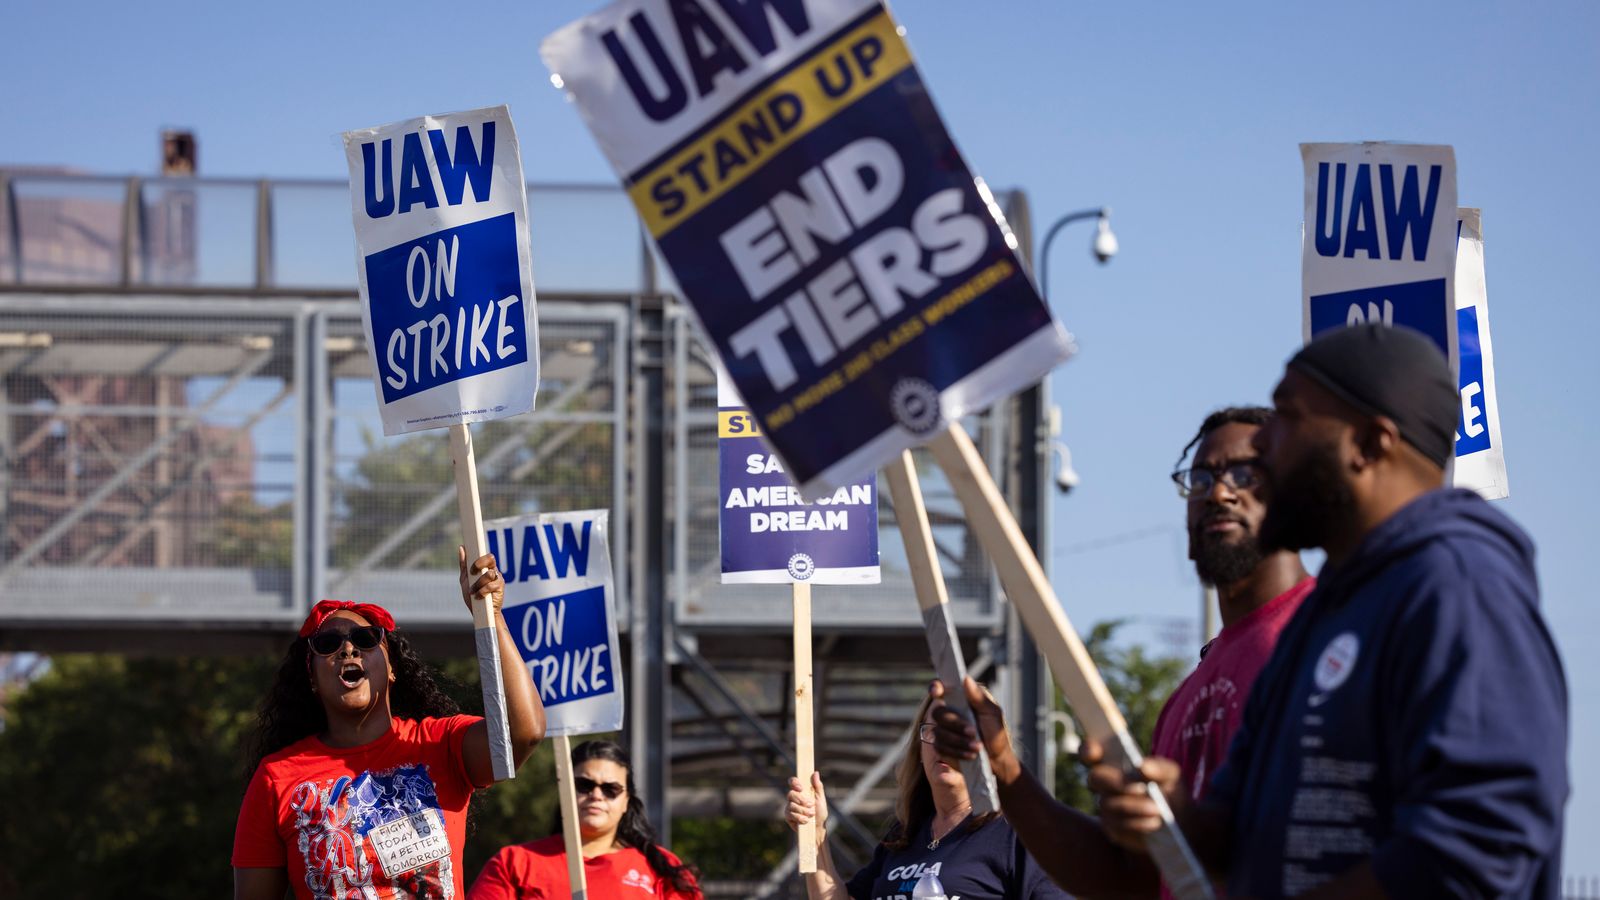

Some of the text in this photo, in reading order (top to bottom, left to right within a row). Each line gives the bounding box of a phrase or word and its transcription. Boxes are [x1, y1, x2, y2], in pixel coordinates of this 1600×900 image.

[600, 0, 811, 124] UAW
[650, 35, 885, 217] STAND UP
[361, 121, 496, 219] UAW
[719, 136, 906, 302] END
[1315, 161, 1443, 262] UAW
[406, 234, 460, 309] ON
[729, 187, 990, 394] TIERS
[386, 294, 519, 391] STRIKE
[793, 371, 846, 413] MORE
[869, 318, 926, 364] CLASS
[923, 260, 1014, 327] WORKERS
[746, 453, 785, 474] SA
[725, 484, 872, 508] AMERAN
[750, 510, 849, 533] DREAM
[487, 520, 593, 585] UAW
[521, 599, 566, 652] ON
[525, 643, 608, 702] RIKE
[377, 823, 437, 850] TODAY FOR
[379, 814, 430, 836] FIGHTING
[390, 835, 440, 860] A BETTER
[385, 846, 447, 875] TOMORROW
[887, 861, 943, 881] COLA
